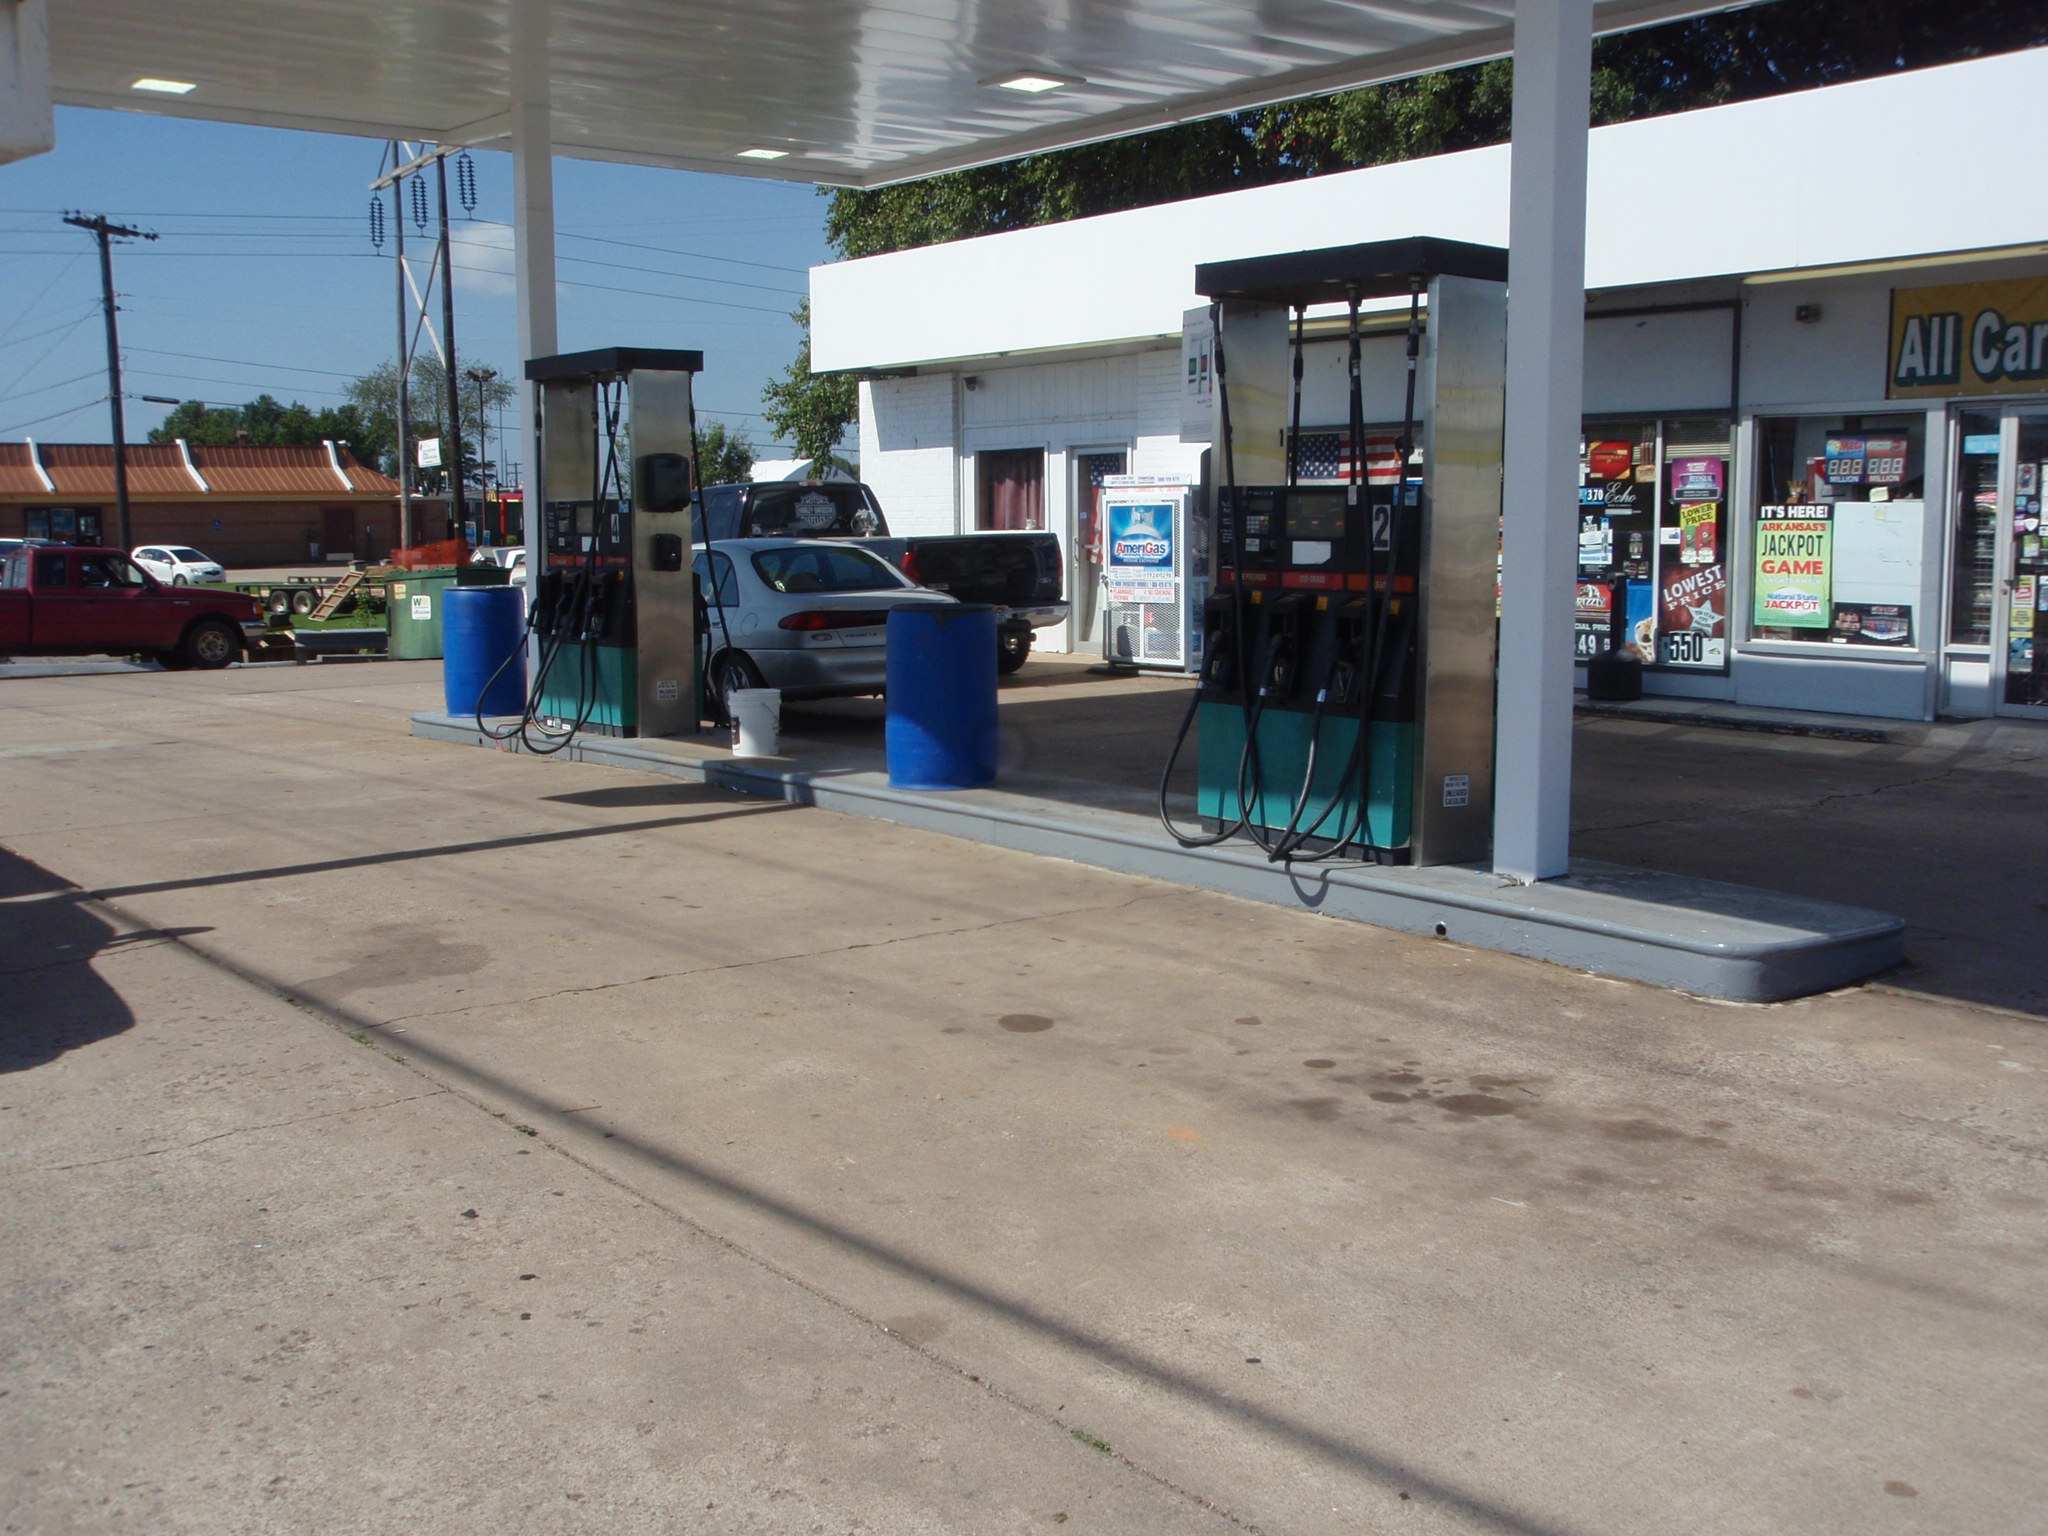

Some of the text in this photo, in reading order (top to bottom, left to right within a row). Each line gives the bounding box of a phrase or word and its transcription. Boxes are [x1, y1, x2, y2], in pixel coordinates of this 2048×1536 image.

[1896, 313, 1960, 382] All
[1829, 475, 1860, 483] MILLION
[1869, 474, 1901, 482] MILLION
[1604, 482, 1636, 504] Echo
[1682, 503, 1714, 518] LOWER
[1761, 505, 1829, 519] IT'S HERE!
[1686, 512, 1713, 526] PRICE
[1374, 506, 1390, 549] 2
[1761, 523, 1827, 532] ARKANSAS'S
[1116, 542, 1166, 554] AmeriGas
[1762, 534, 1824, 557] JACKPOT
[1761, 560, 1824, 575] GAME
[1663, 565, 1722, 602] LOWEST
[1668, 580, 1726, 610] PRICE
[1767, 593, 1819, 602] Natural State
[1575, 597, 1606, 608] RIZZLY
[1764, 600, 1819, 611] JACKPOT
[1575, 622, 1611, 632] CIAL PRIC
[1670, 632, 1704, 663] 550
